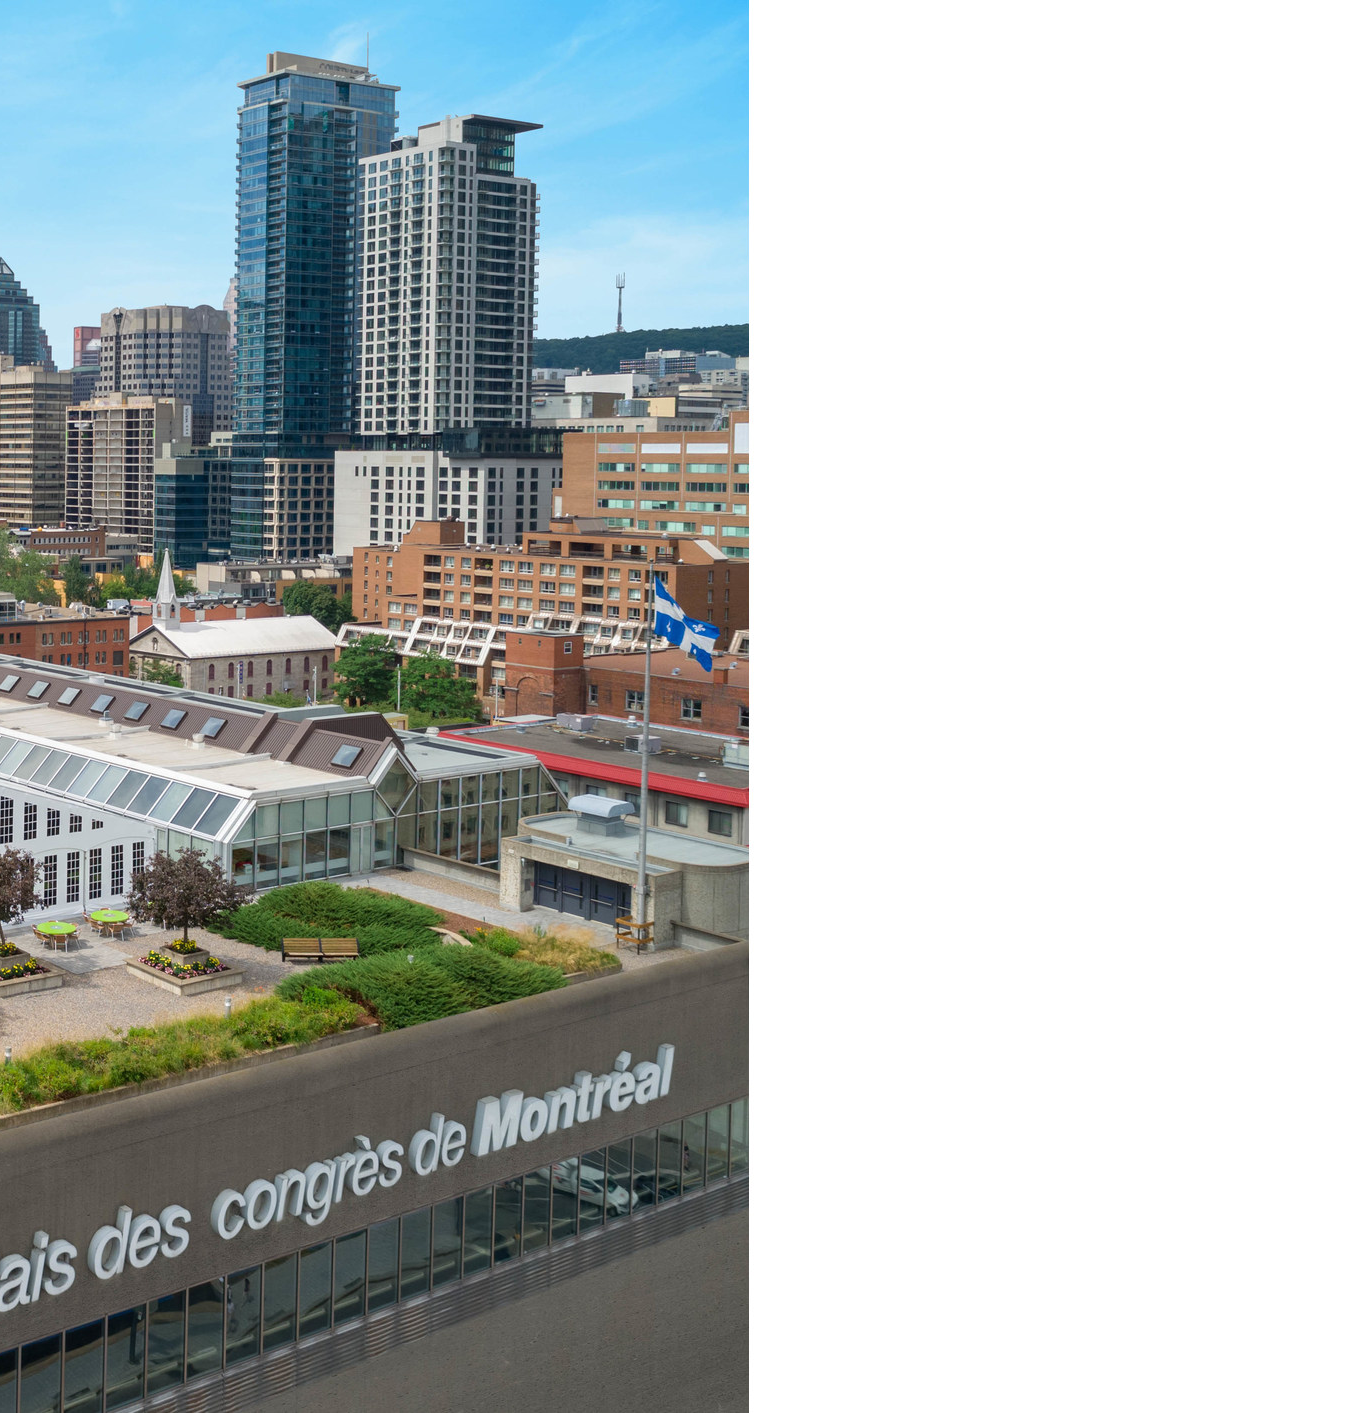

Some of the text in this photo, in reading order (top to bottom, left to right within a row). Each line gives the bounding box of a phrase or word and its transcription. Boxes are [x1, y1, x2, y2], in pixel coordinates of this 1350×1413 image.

[87, 1205, 192, 1280] des
[210, 1134, 404, 1240] congrès
[408, 1112, 467, 1176] de
[470, 1043, 675, 1157] Montréal
